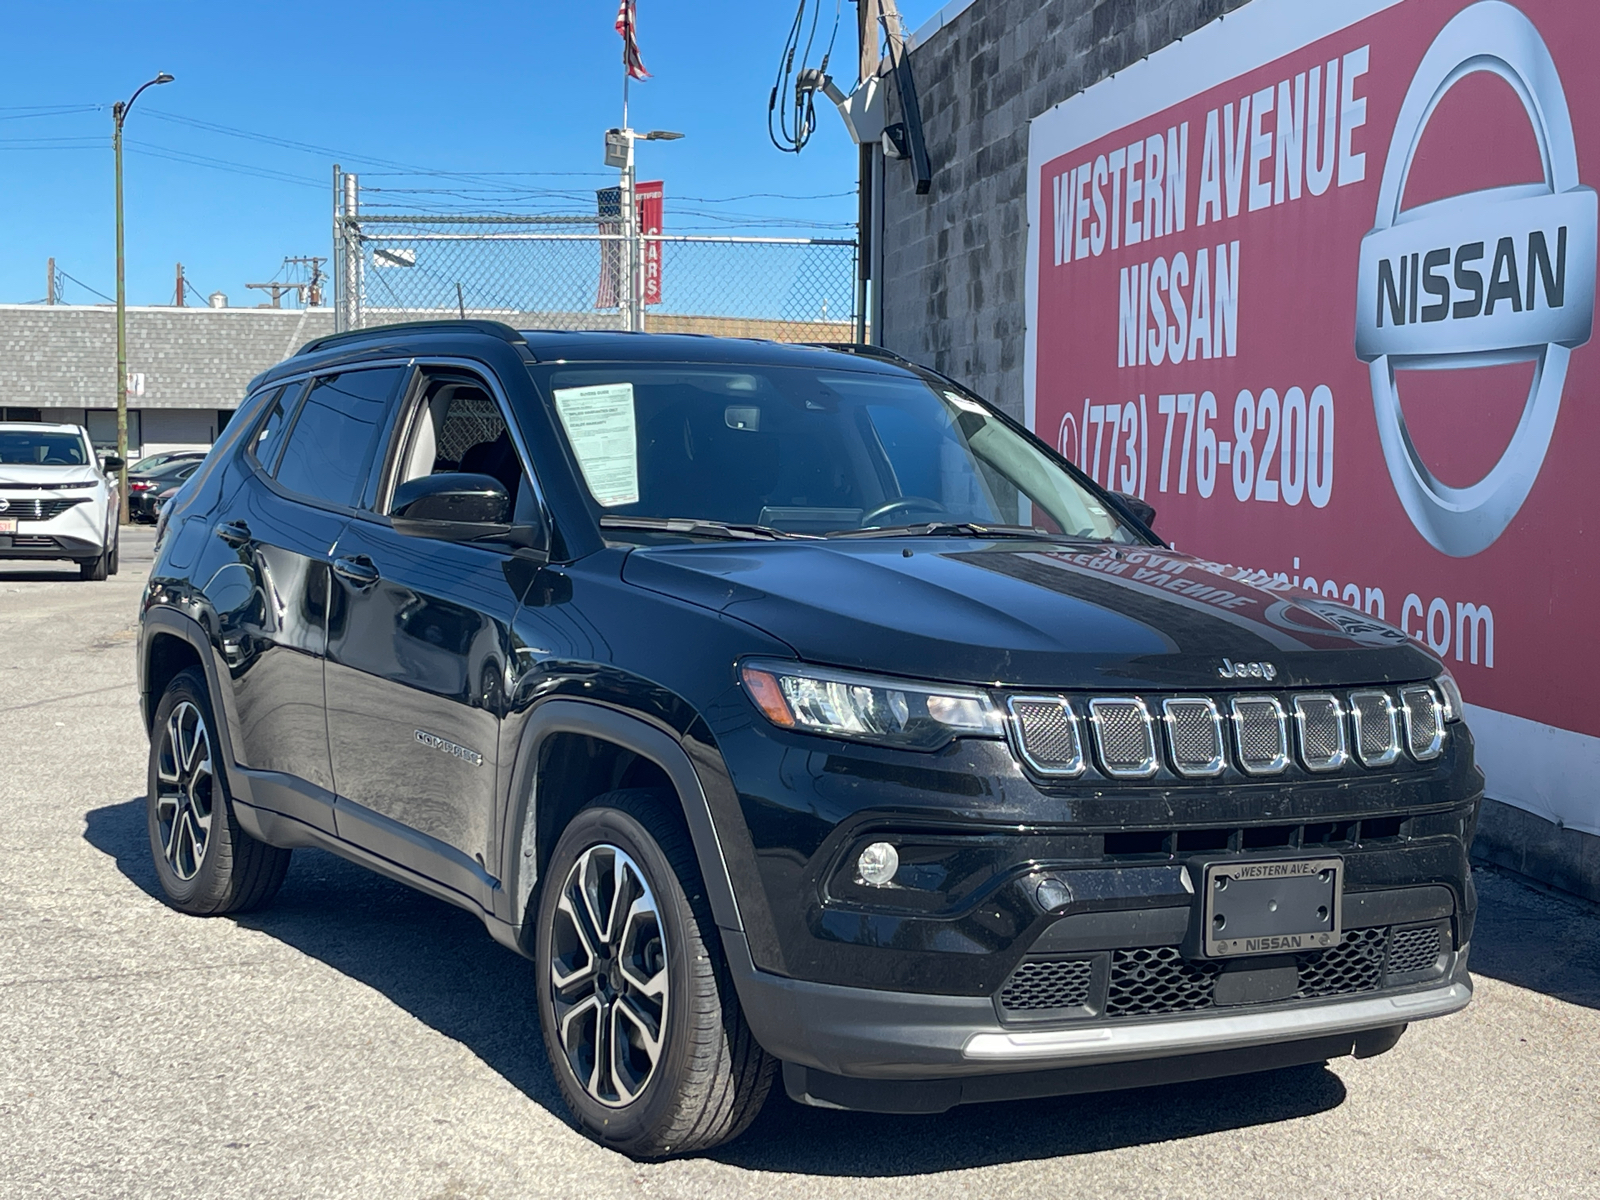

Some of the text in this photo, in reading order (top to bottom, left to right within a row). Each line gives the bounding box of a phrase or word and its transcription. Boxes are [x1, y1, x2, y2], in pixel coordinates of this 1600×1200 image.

[1052, 44, 1371, 267] WESTERN AVENUE
[1118, 240, 1241, 369] NISSAN
[1376, 226, 1568, 329] NISSAN
[1080, 384, 1335, 509] (773) 776-8200
[1218, 657, 1278, 681] Jeep
[1240, 864, 1287, 878] WESTERN
[1246, 937, 1301, 951] NISSAN
